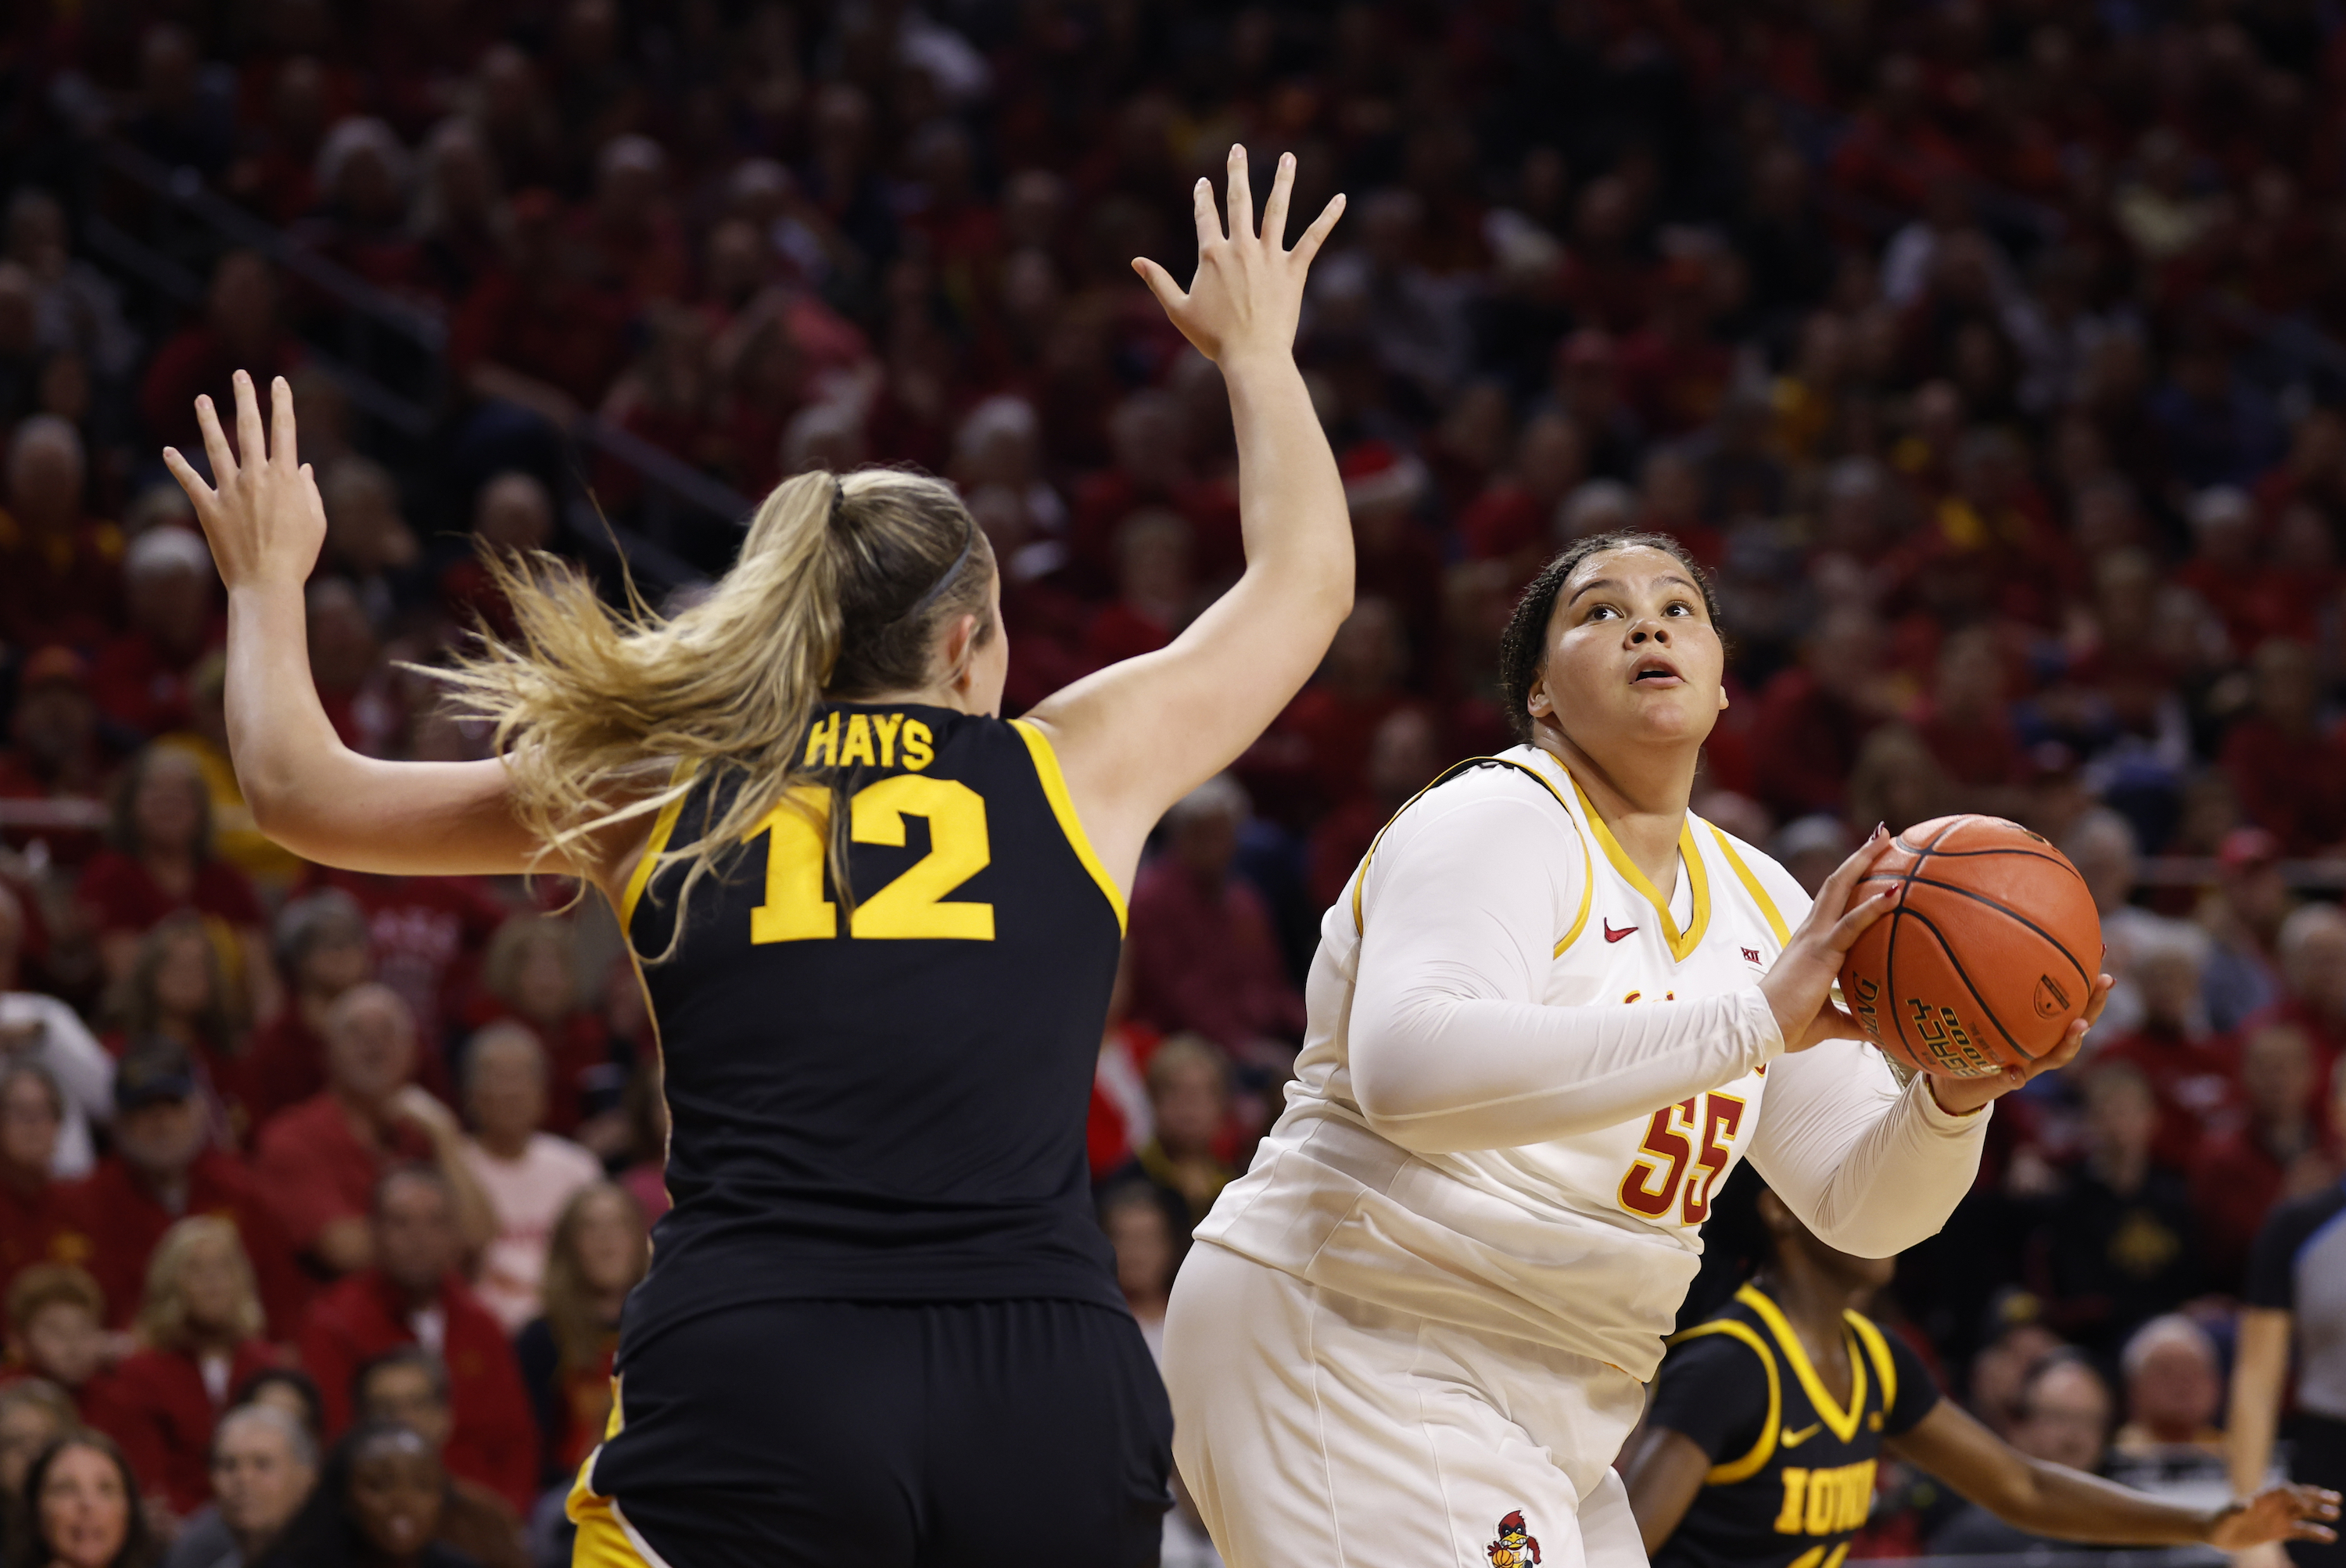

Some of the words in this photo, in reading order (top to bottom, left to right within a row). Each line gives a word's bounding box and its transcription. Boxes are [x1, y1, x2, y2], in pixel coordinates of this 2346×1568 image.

[804, 710, 935, 772] HAYS
[740, 774, 996, 945] 12
[1617, 1089, 1747, 1227] 55
